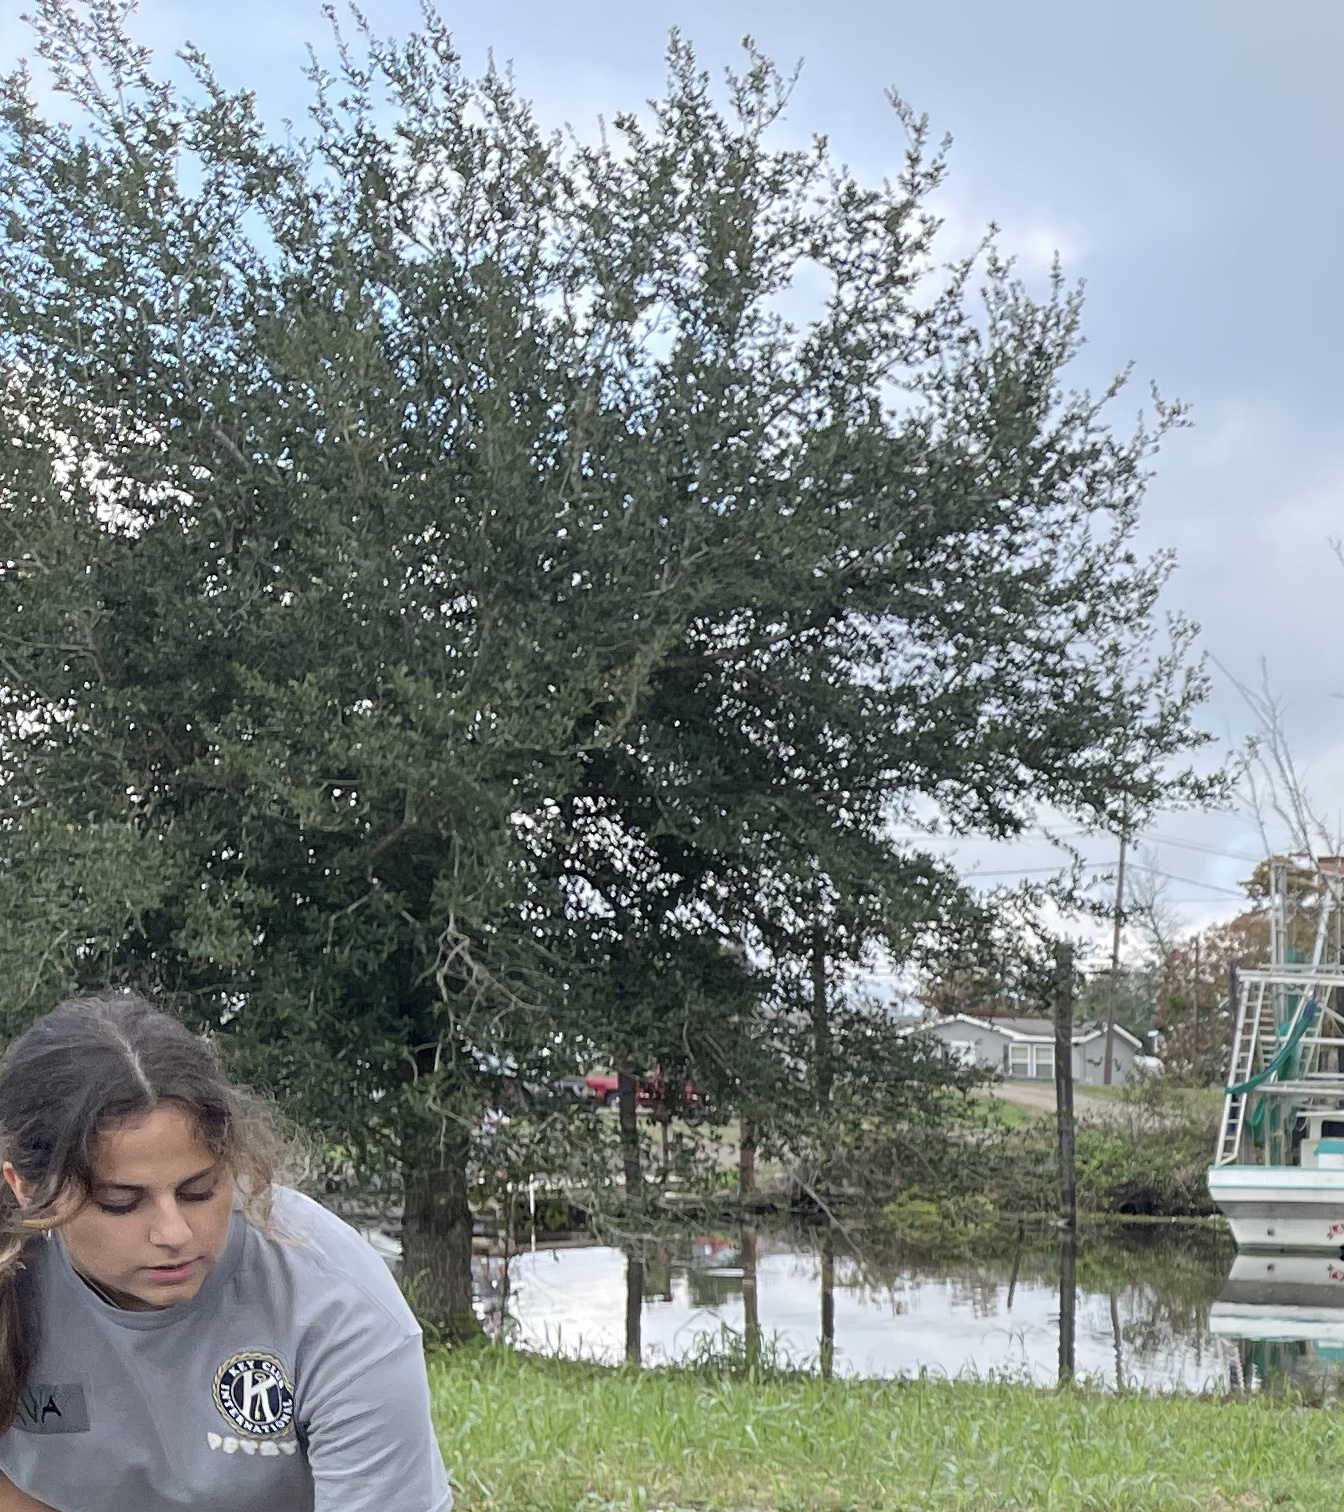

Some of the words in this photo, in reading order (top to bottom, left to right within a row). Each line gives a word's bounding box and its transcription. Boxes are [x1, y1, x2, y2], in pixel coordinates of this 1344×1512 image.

[229, 1360, 255, 1377] KEY
[16, 1393, 62, 1426] VA
[220, 1383, 293, 1434] INTERNATIONAL
